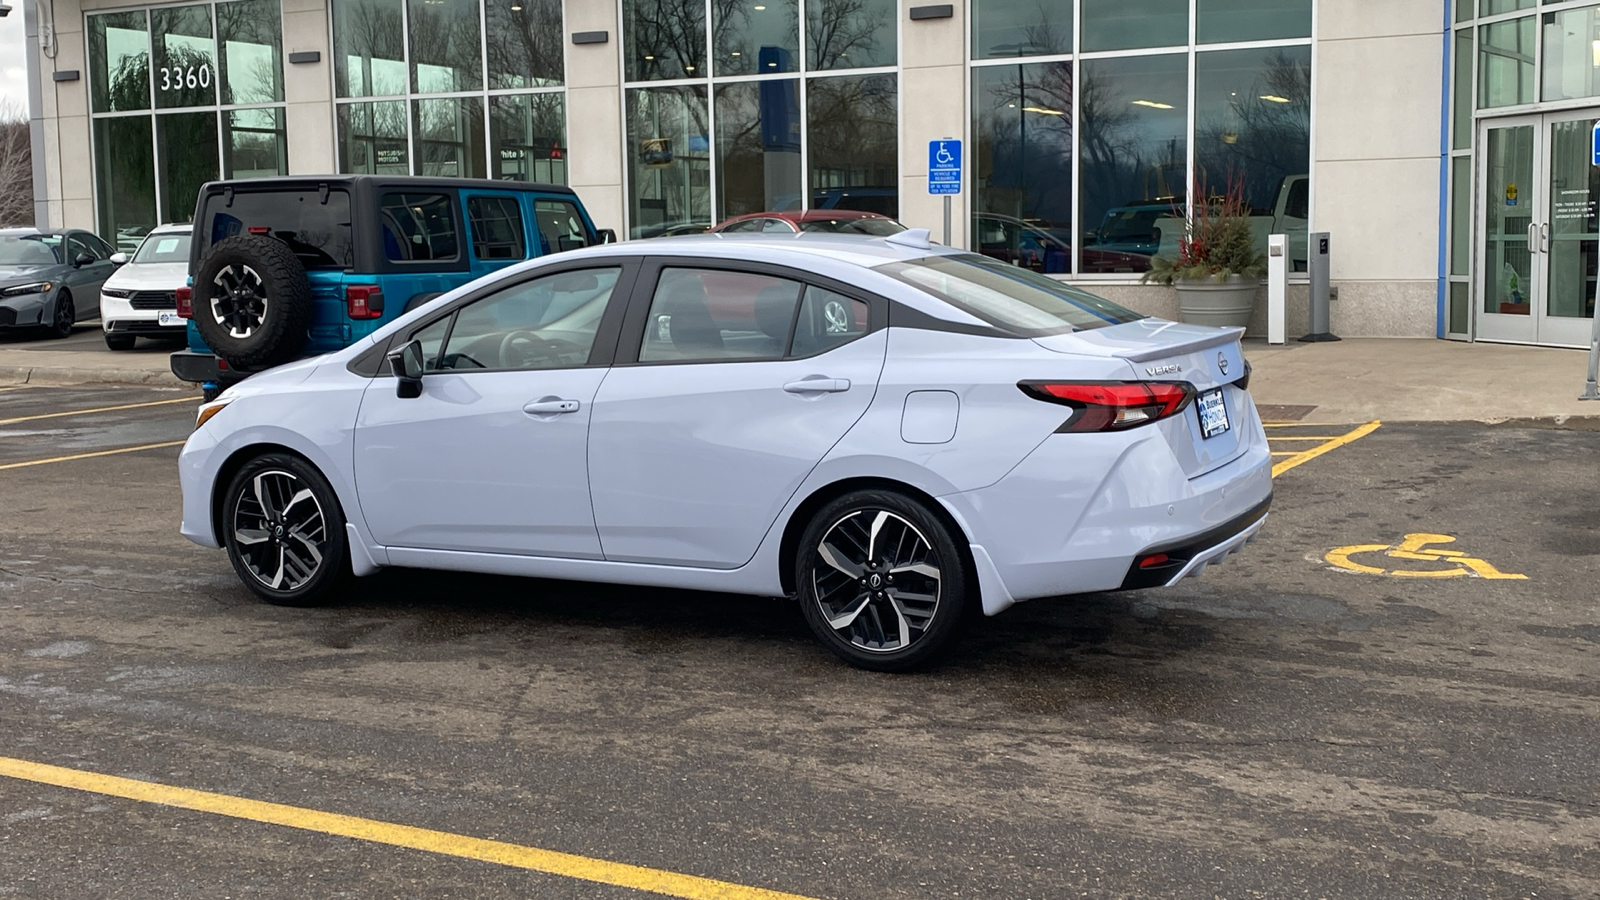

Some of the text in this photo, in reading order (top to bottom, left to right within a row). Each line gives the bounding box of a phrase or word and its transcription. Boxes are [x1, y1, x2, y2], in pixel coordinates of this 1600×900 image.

[160, 64, 210, 91] 3360
[1146, 364, 1182, 376] VERSA
[1206, 397, 1223, 409] BUERKLE
